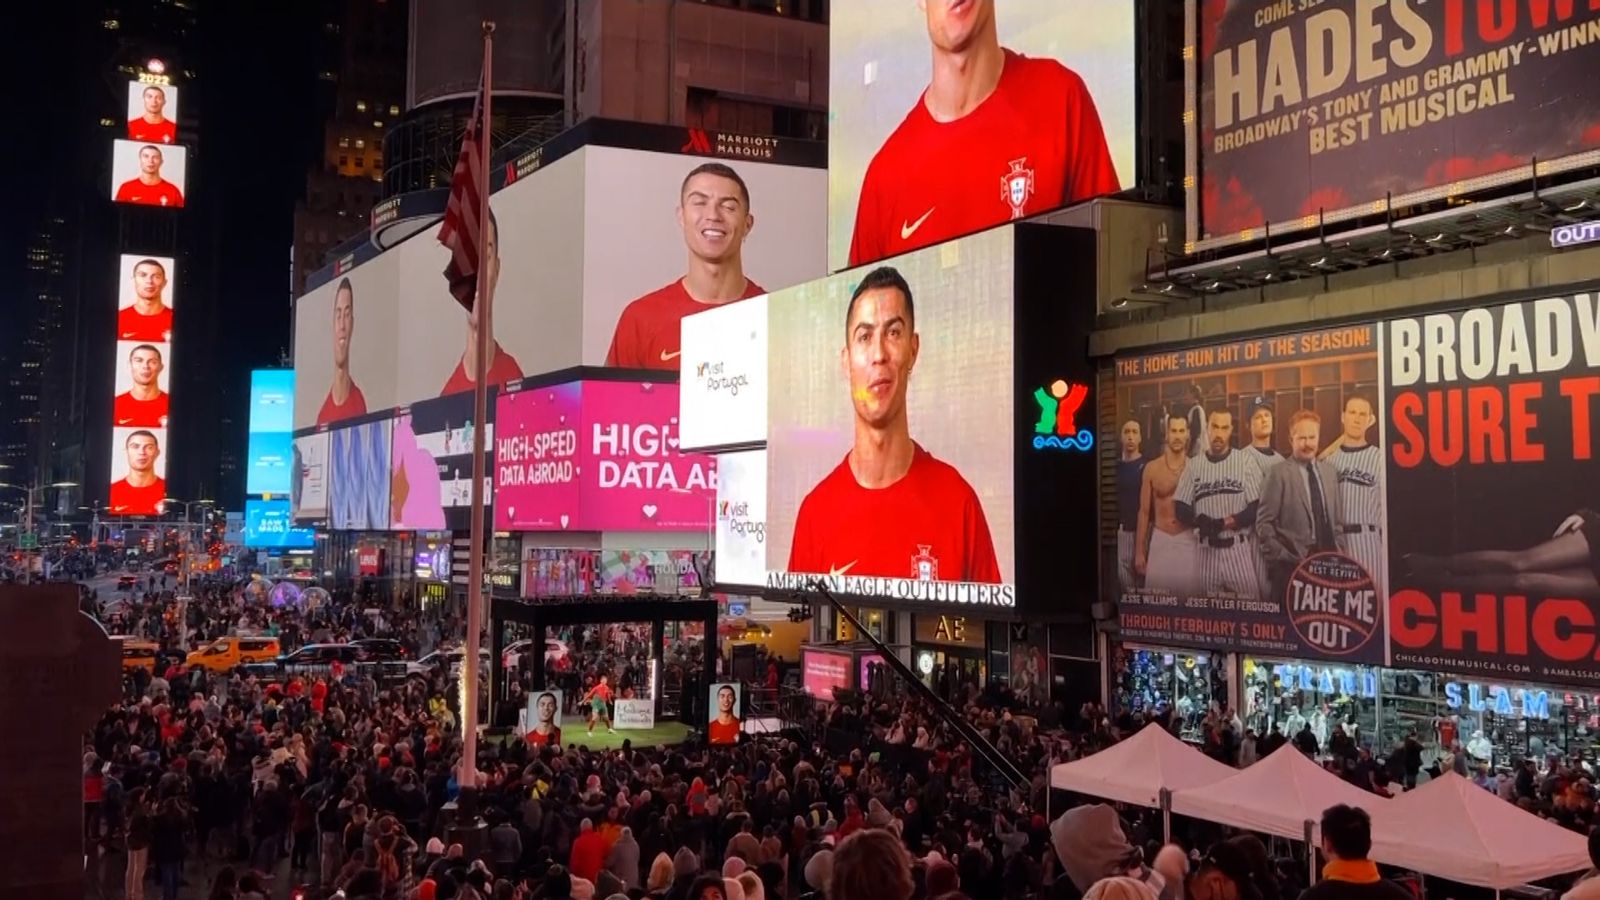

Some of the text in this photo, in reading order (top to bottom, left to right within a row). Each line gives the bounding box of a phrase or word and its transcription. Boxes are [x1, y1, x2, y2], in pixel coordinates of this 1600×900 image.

[1255, 1, 1296, 28] COME
[139, 72, 171, 86] 2022
[1215, 105, 1319, 154] BROADWAY'S
[1379, 75, 1419, 104] AND
[1310, 73, 1516, 155] BEST MUSICAL
[717, 133, 778, 148] MARRIOTT
[717, 144, 771, 158] MARQUIS
[1117, 327, 1371, 377] THE HOME-RUN HIT OF THE SEASON!
[1392, 381, 1545, 468] SURE
[500, 460, 573, 486] DATA ABROAD
[599, 460, 679, 489] DATA
[730, 501, 749, 516] visit
[730, 518, 766, 543] Portug
[1308, 565, 1327, 576] BEST
[1330, 568, 1361, 580] REVIVAL
[844, 576, 893, 597] EAGLE
[897, 579, 1014, 606] OUTFITTERS
[1120, 594, 1178, 606] JESSE WILLIAMS
[1292, 580, 1375, 625] TAKE ME
[1184, 597, 1280, 613] JESSE TYLER FERGUSON
[935, 614, 966, 643] AE
[1120, 613, 1286, 640] THROUGH FEBRUARY 5 ONLY
[1308, 621, 1351, 649] OUT
[1390, 589, 1600, 662] CHIC
[1395, 653, 1531, 673] CHICAGOTHEMUSICAL.COM
[1280, 664, 1550, 720] GRAND SLAM
